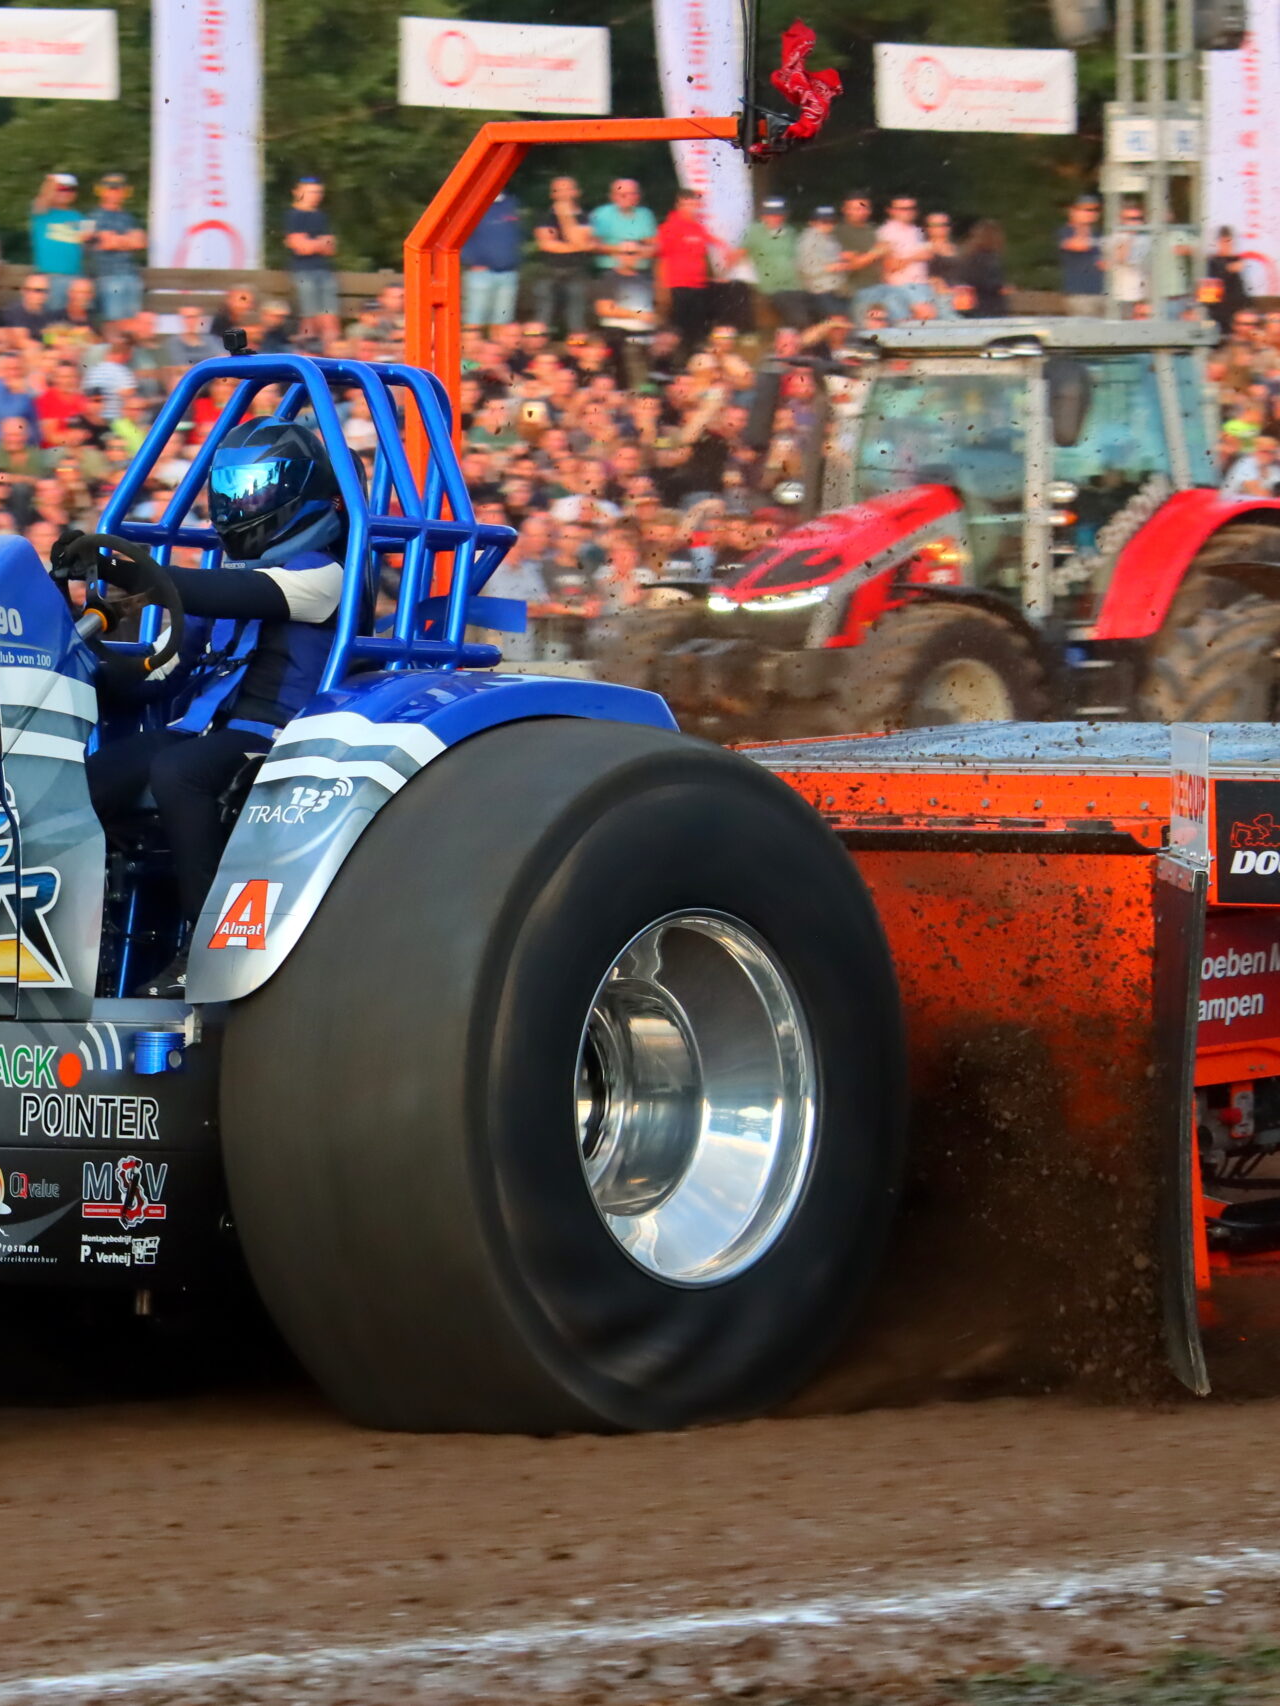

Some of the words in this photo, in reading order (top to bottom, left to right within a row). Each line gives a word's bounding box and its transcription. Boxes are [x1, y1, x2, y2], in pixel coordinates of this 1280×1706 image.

[17, 655, 35, 665] van
[36, 654, 52, 667] 100
[290, 786, 334, 812] 123
[246, 805, 312, 825] TRACK
[1229, 850, 1280, 876] DO
[219, 921, 263, 936] Almat
[1200, 947, 1267, 981] oeben
[1198, 992, 1264, 1026] ampen
[19, 1092, 160, 1140] POINTER
[81, 1234, 132, 1245] Montagebedrijf
[80, 1245, 94, 1263] P.
[96, 1252, 132, 1267] Verheij
